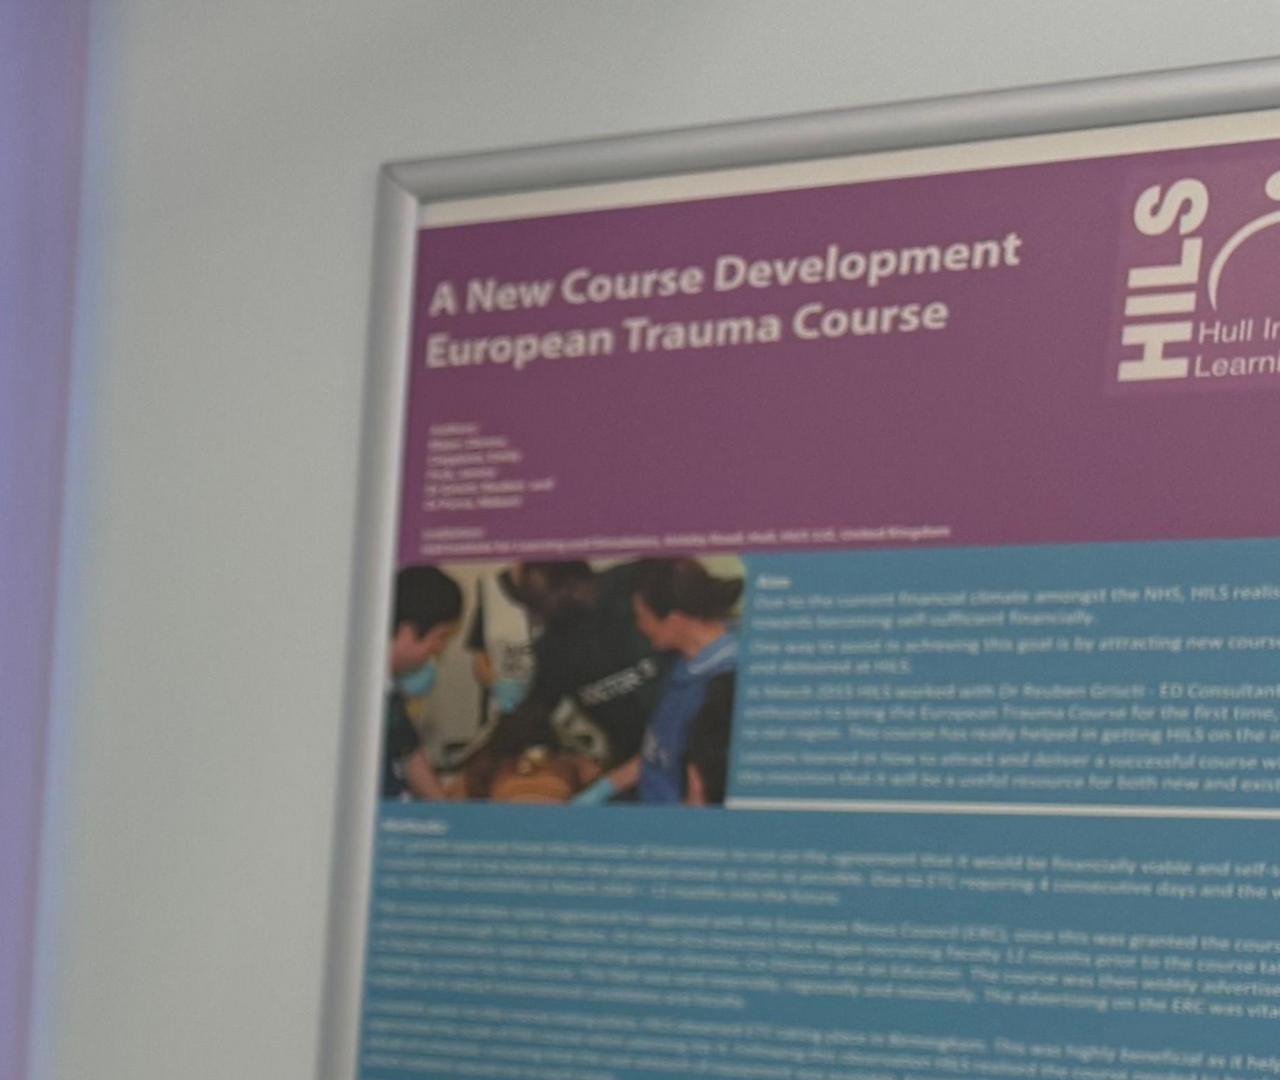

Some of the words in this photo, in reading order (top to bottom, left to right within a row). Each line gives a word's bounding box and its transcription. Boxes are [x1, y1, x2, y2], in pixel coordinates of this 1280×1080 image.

[428, 280, 457, 316] A
[466, 275, 555, 315] New
[561, 262, 704, 303] Course
[713, 232, 1023, 290] Development
[1117, 177, 1209, 382] HILS
[426, 320, 614, 369] European
[623, 307, 782, 352] Trauma
[793, 297, 949, 340] Course
[1198, 318, 1255, 344] Hull
[1110, 587, 1139, 603] the
[1144, 585, 1184, 603] NHS,
[1190, 583, 1230, 601] HILS
[1185, 637, 1224, 651] new
[1159, 683, 1184, 698] ED
[1160, 705, 1190, 719] the
[1167, 726, 1204, 742] HILS
[1207, 729, 1232, 742] on
[1235, 726, 1265, 742] the
[1199, 756, 1259, 769] course
[1161, 777, 1200, 791] new
[1203, 775, 1237, 791] and
